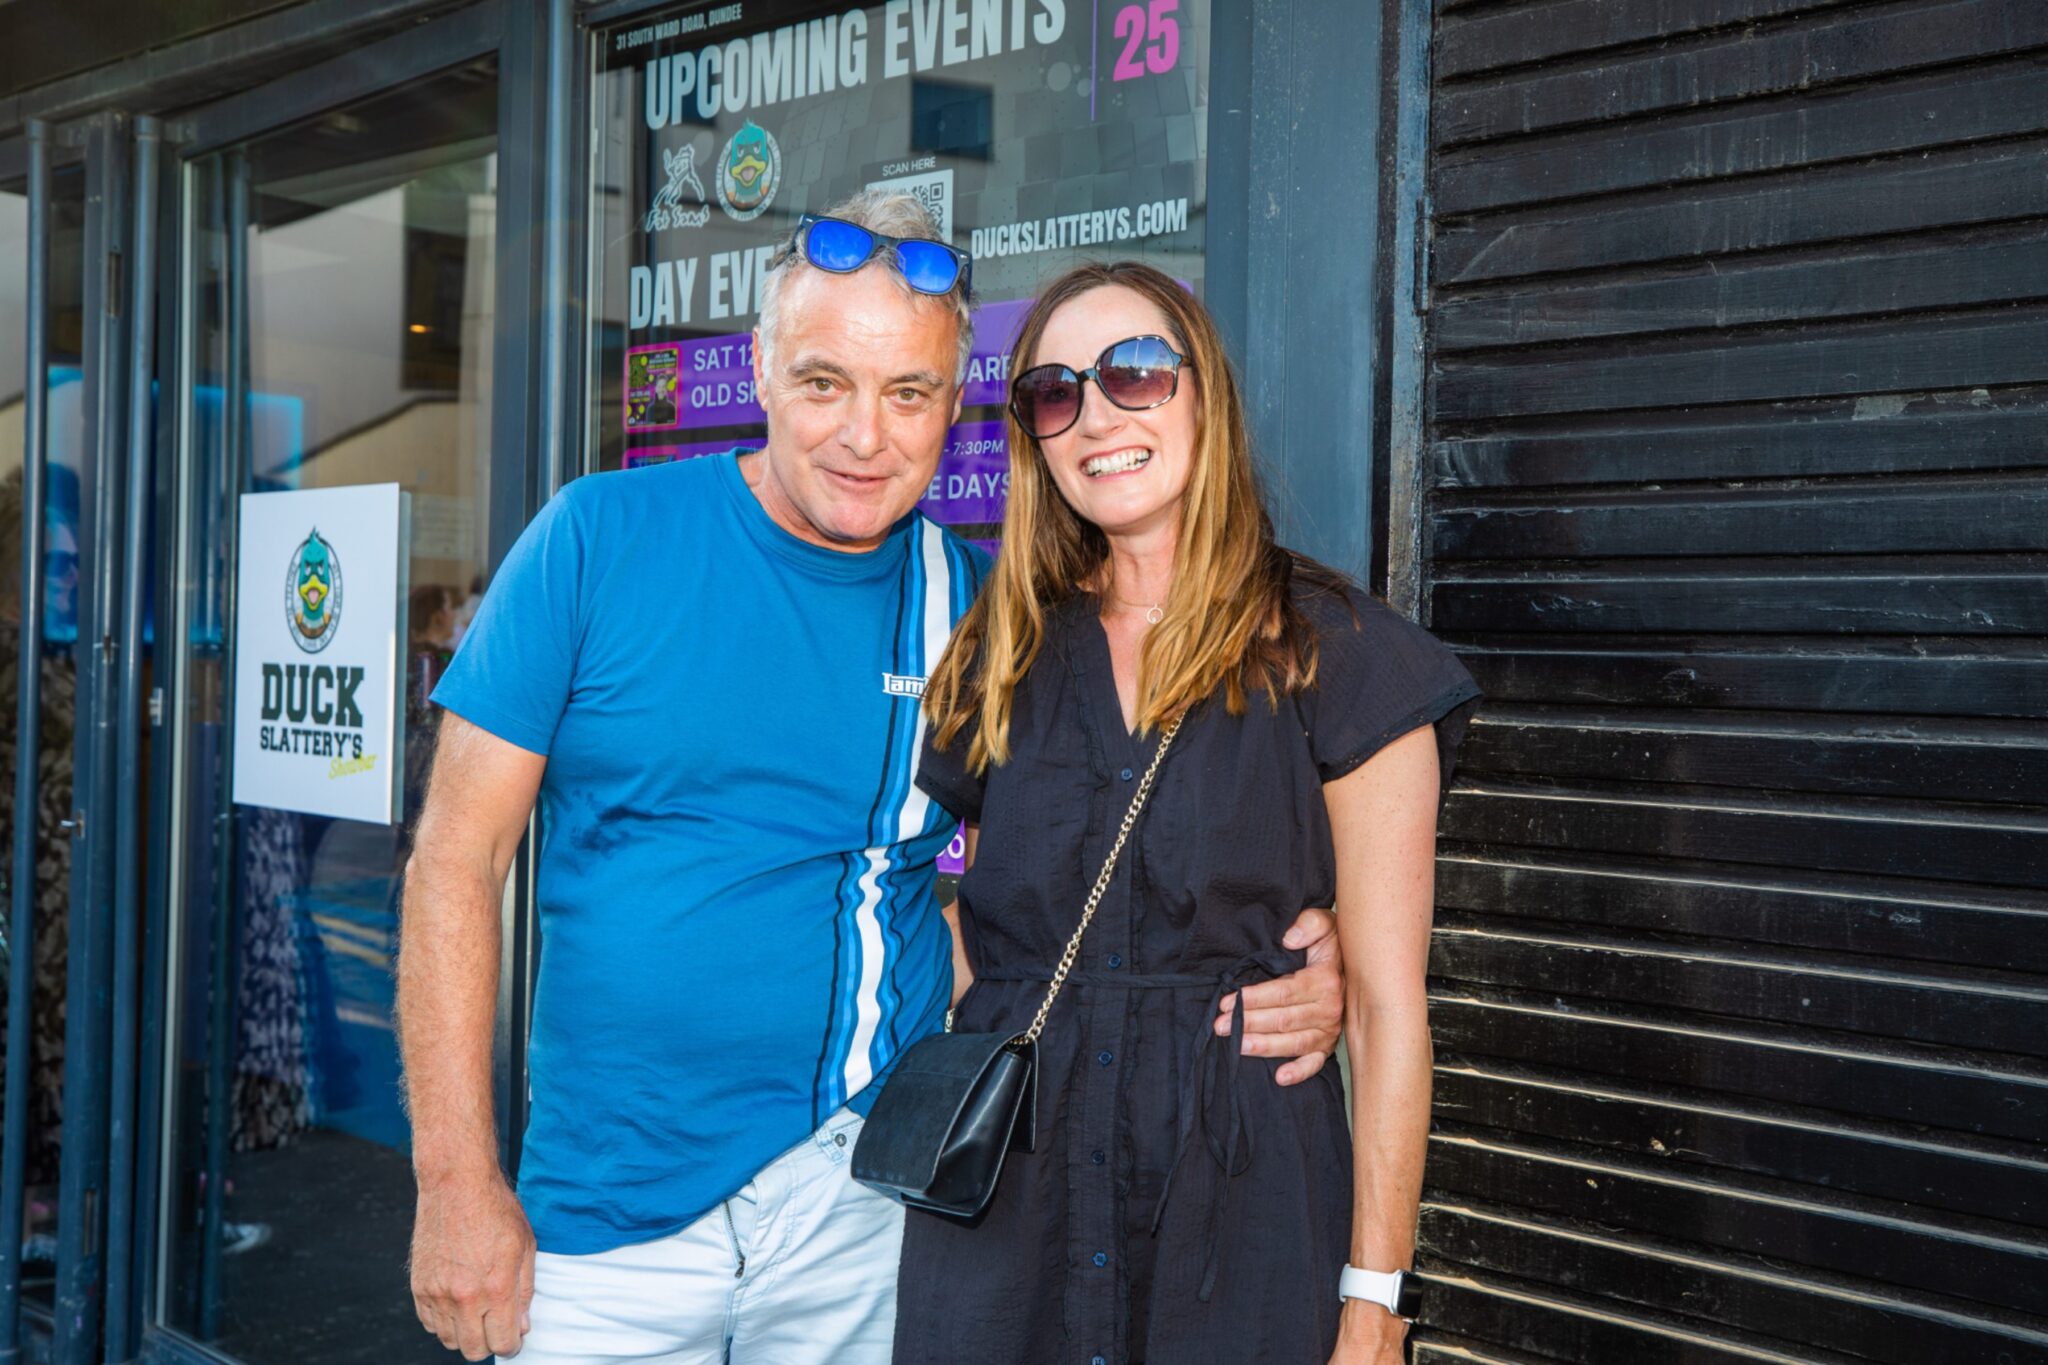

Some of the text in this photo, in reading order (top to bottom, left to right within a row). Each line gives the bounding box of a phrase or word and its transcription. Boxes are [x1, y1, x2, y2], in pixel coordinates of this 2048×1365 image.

[616, 3, 743, 50] 31 SOUTH WARD ROAD, DUNDEE
[1113, 0, 1180, 82] 25
[646, 8, 868, 130] UPCOMING
[882, 156, 936, 177] SCAN HERE
[971, 198, 1188, 260] DUCKSLATTERYS.COM
[630, 244, 780, 330] DAY EVE
[694, 345, 734, 372] SAT
[691, 383, 731, 409] OLD
[953, 439, 1005, 456] 7:30PM
[261, 662, 365, 728] DUCK
[882, 672, 930, 700] Lam
[260, 725, 363, 760] SLATTERY'S
